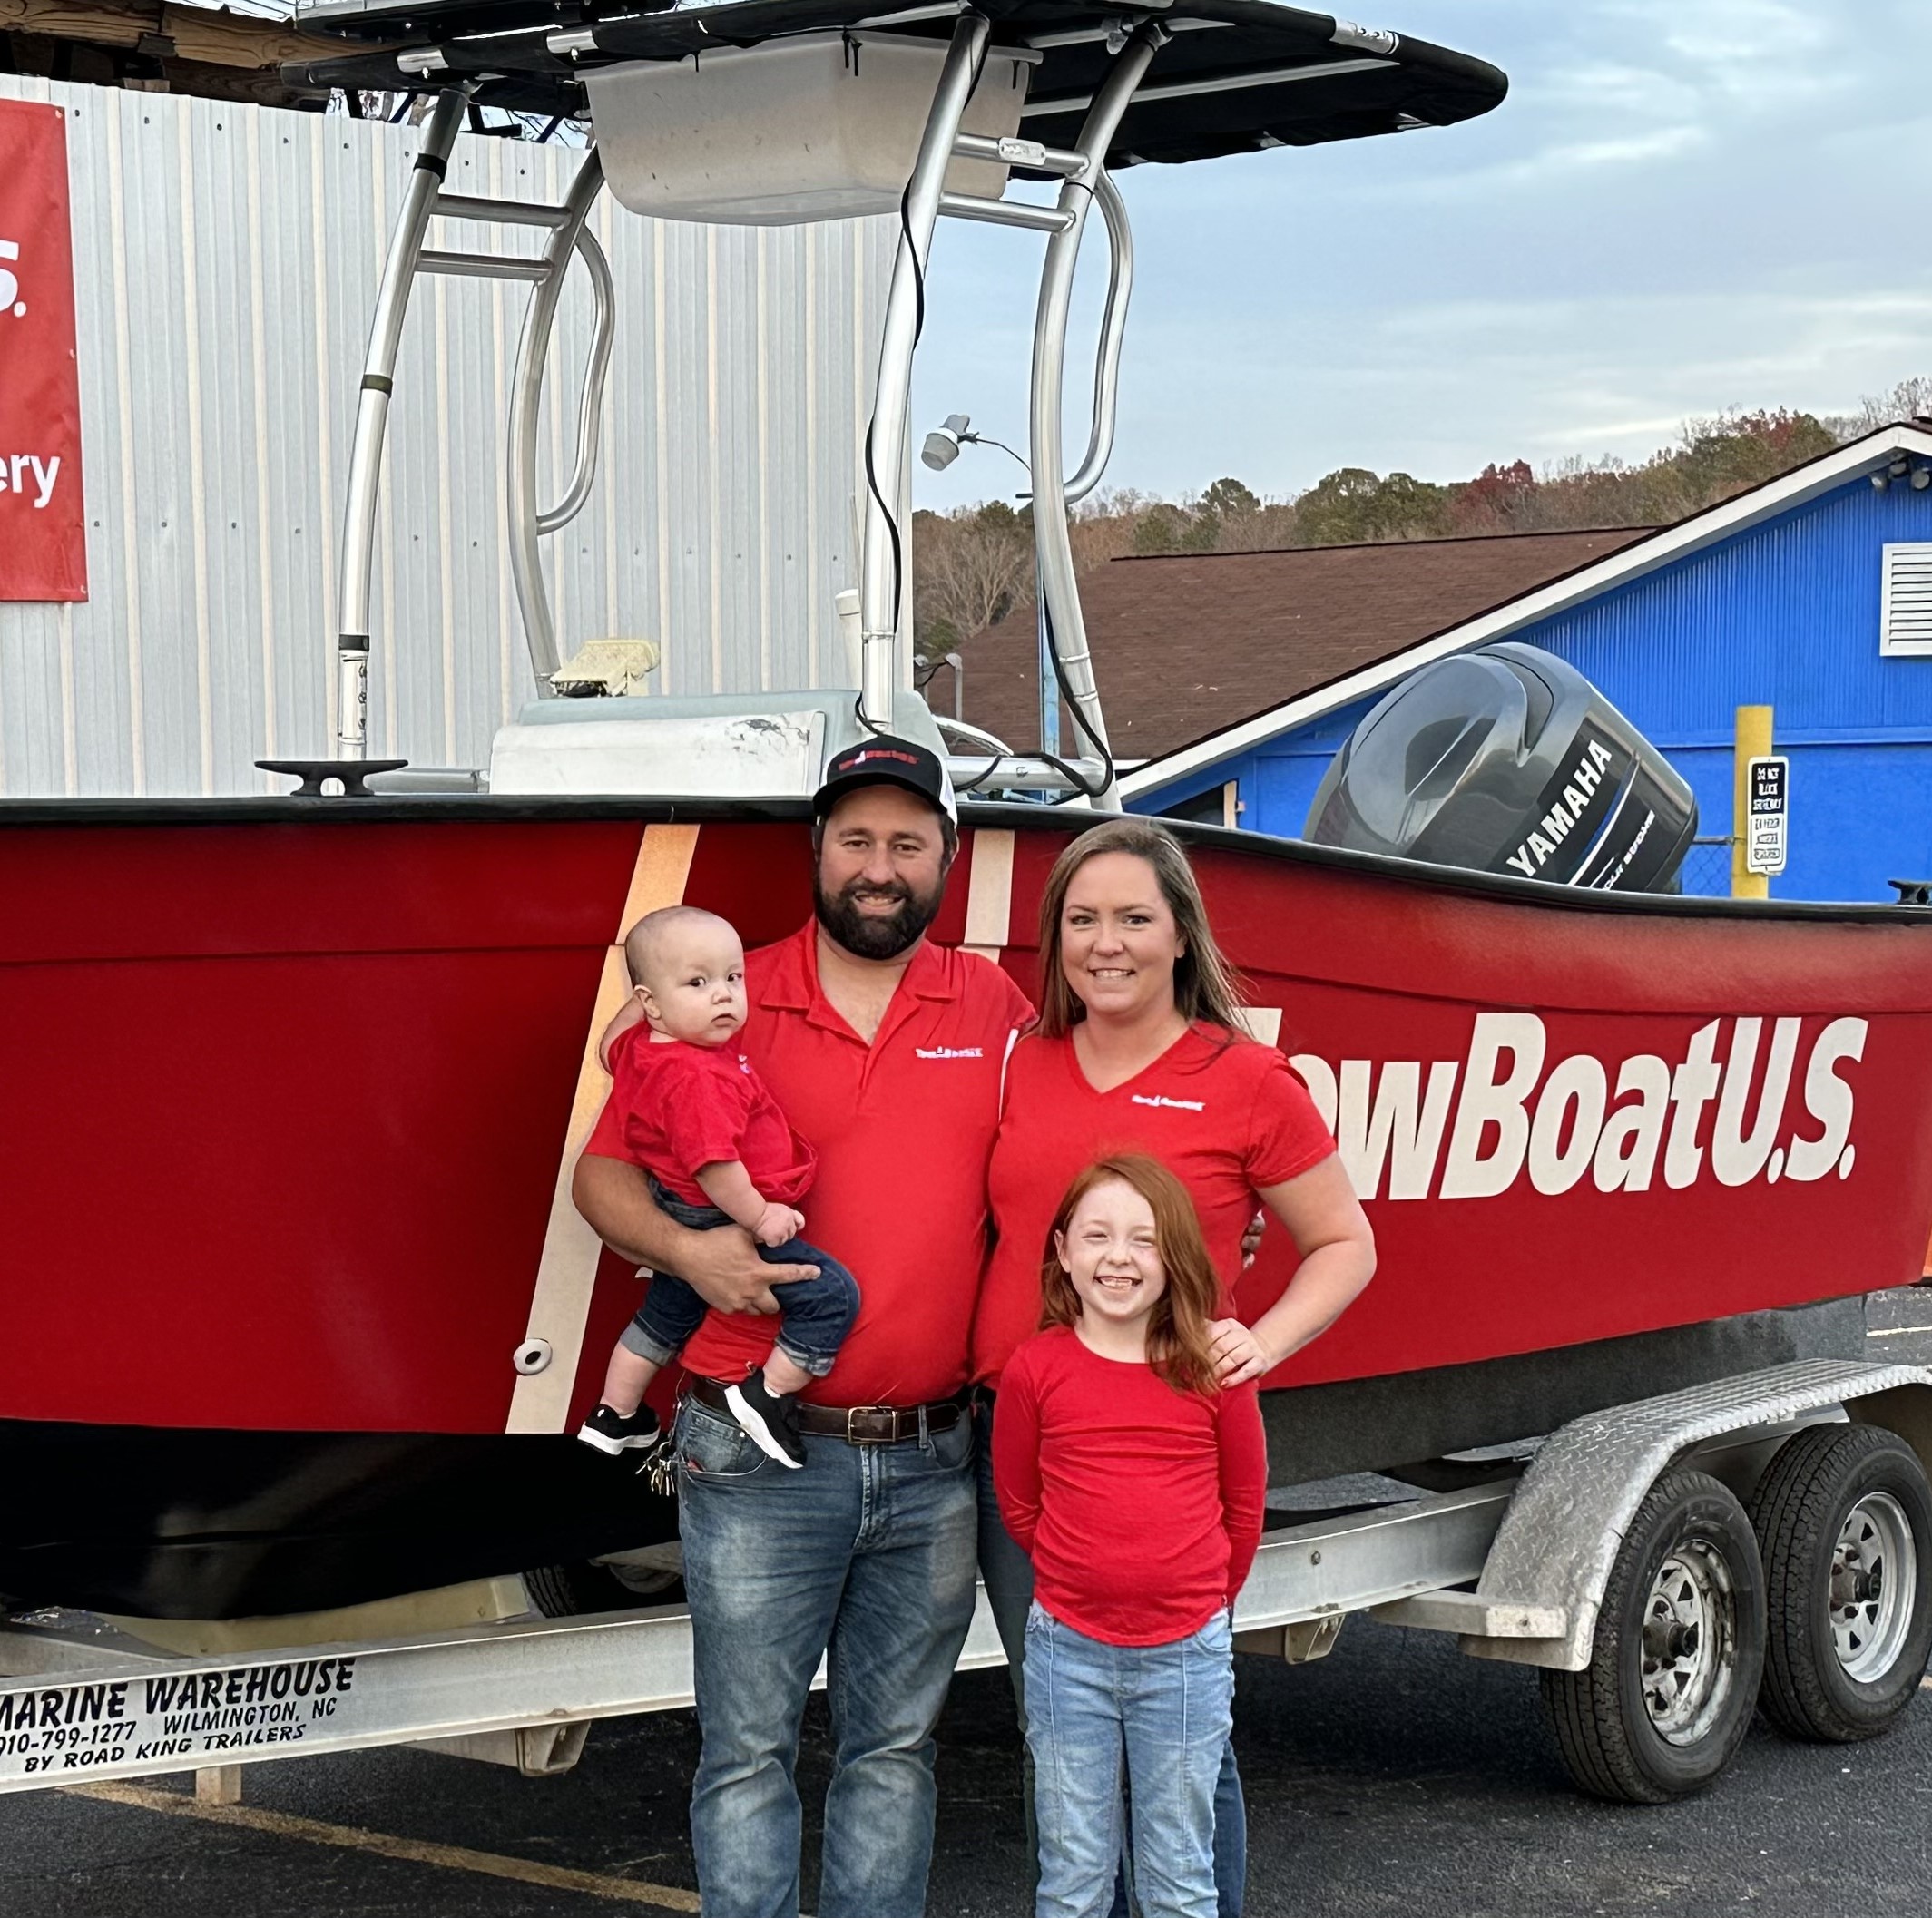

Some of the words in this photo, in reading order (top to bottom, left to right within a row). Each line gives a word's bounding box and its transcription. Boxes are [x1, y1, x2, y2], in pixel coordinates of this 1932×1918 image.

[1505, 739, 1613, 877] YAMAHA
[146, 1658, 356, 1714] WAREHOUSE
[164, 1700, 300, 1735] WILMINGTON,
[312, 1696, 338, 1720] NC
[25, 1755, 54, 1773] BY
[63, 1747, 125, 1768] ROAD
[135, 1737, 192, 1760] KING
[204, 1724, 307, 1750] TRAILERS
